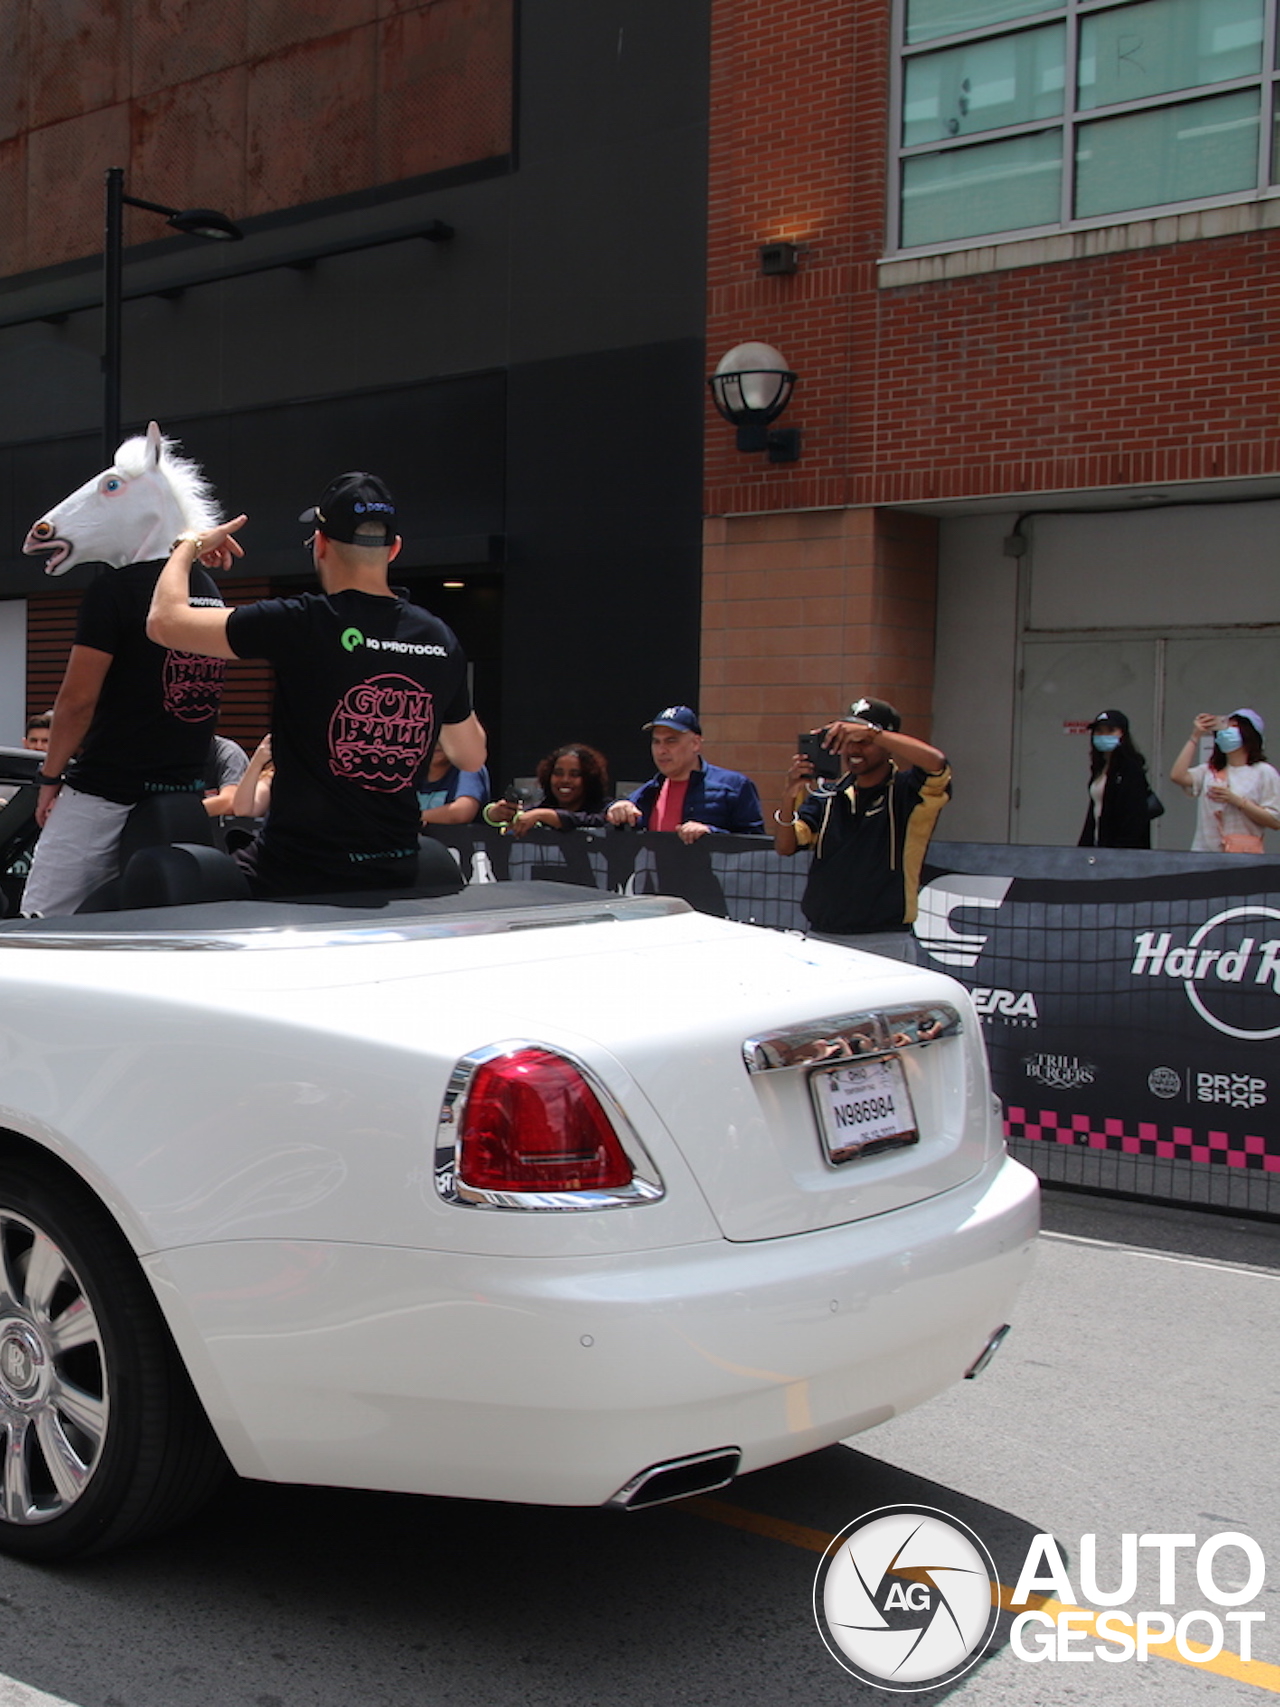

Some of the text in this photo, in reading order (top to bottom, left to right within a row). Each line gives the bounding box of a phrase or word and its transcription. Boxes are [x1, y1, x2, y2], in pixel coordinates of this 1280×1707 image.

[381, 640, 448, 657] PROTOCOL
[343, 685, 433, 721] GUM
[335, 715, 426, 756] BALL
[1130, 931, 1255, 982] Hard
[1037, 1053, 1079, 1070] TRILL
[1026, 1063, 1095, 1084] BURGERS
[1197, 1072, 1268, 1092] DROP
[1197, 1087, 1268, 1109] SHOP
[833, 1094, 896, 1129] N986984
